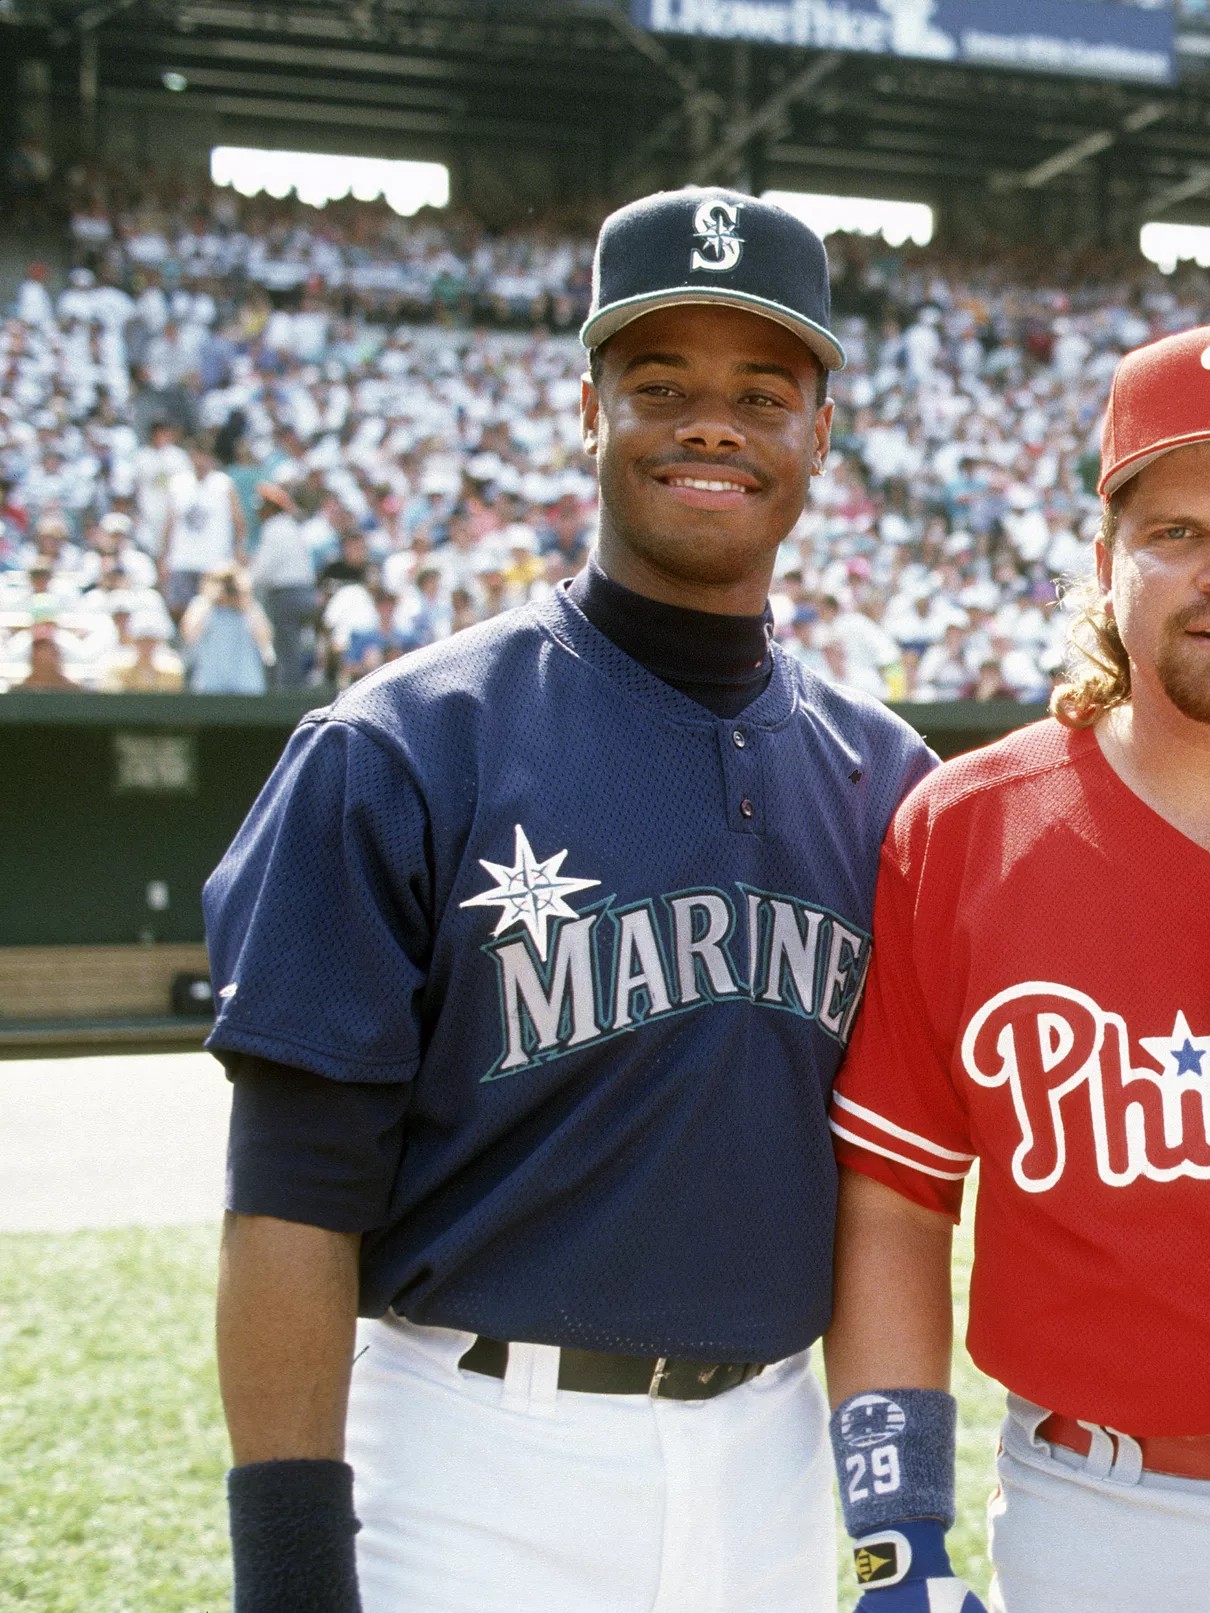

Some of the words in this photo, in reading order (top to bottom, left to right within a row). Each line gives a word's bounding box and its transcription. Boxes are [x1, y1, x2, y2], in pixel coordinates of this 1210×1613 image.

[690, 200, 744, 273] S
[480, 882, 872, 1082] MARINE
[846, 1444, 900, 1503] 29
